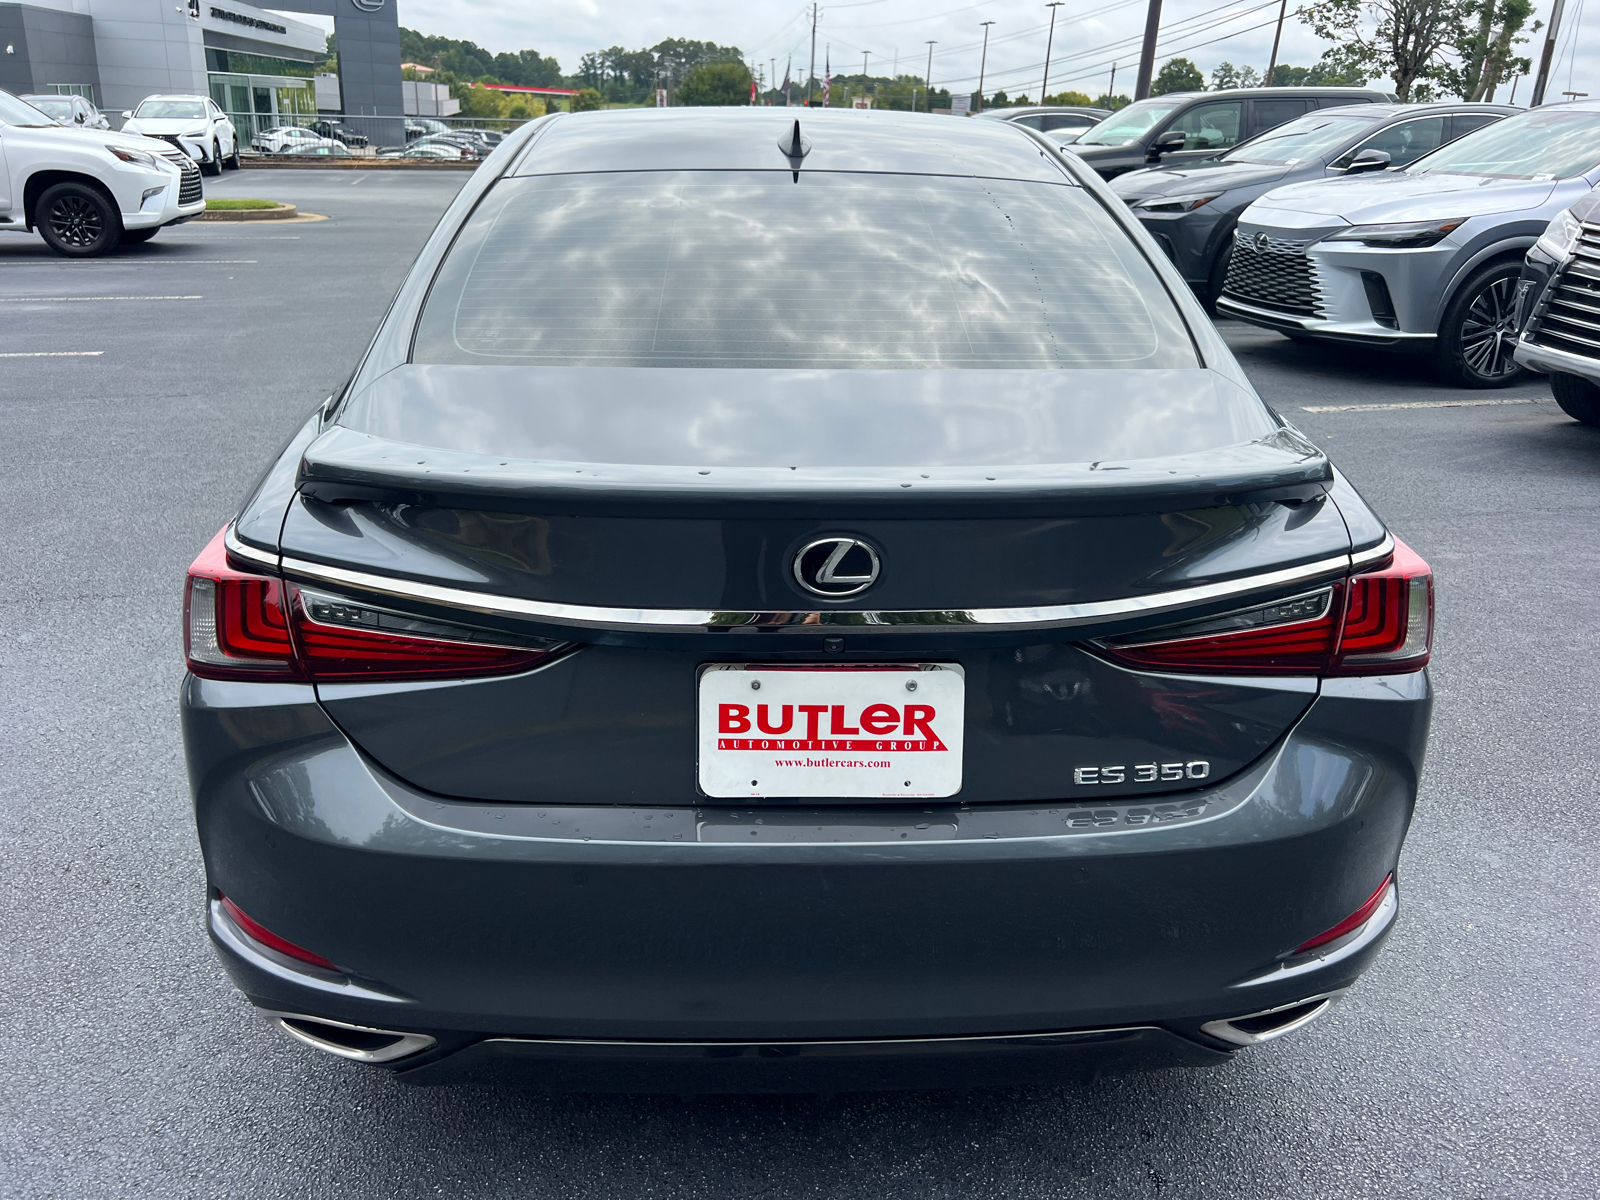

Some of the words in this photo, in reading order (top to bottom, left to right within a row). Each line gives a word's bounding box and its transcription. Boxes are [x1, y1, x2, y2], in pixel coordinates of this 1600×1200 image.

[719, 740, 853, 750] AUTOMOTIVE
[876, 740, 940, 750] GROUP
[775, 758, 891, 768] www.butlercars.com
[1074, 765, 1126, 785] ES
[1133, 761, 1210, 782] 350
